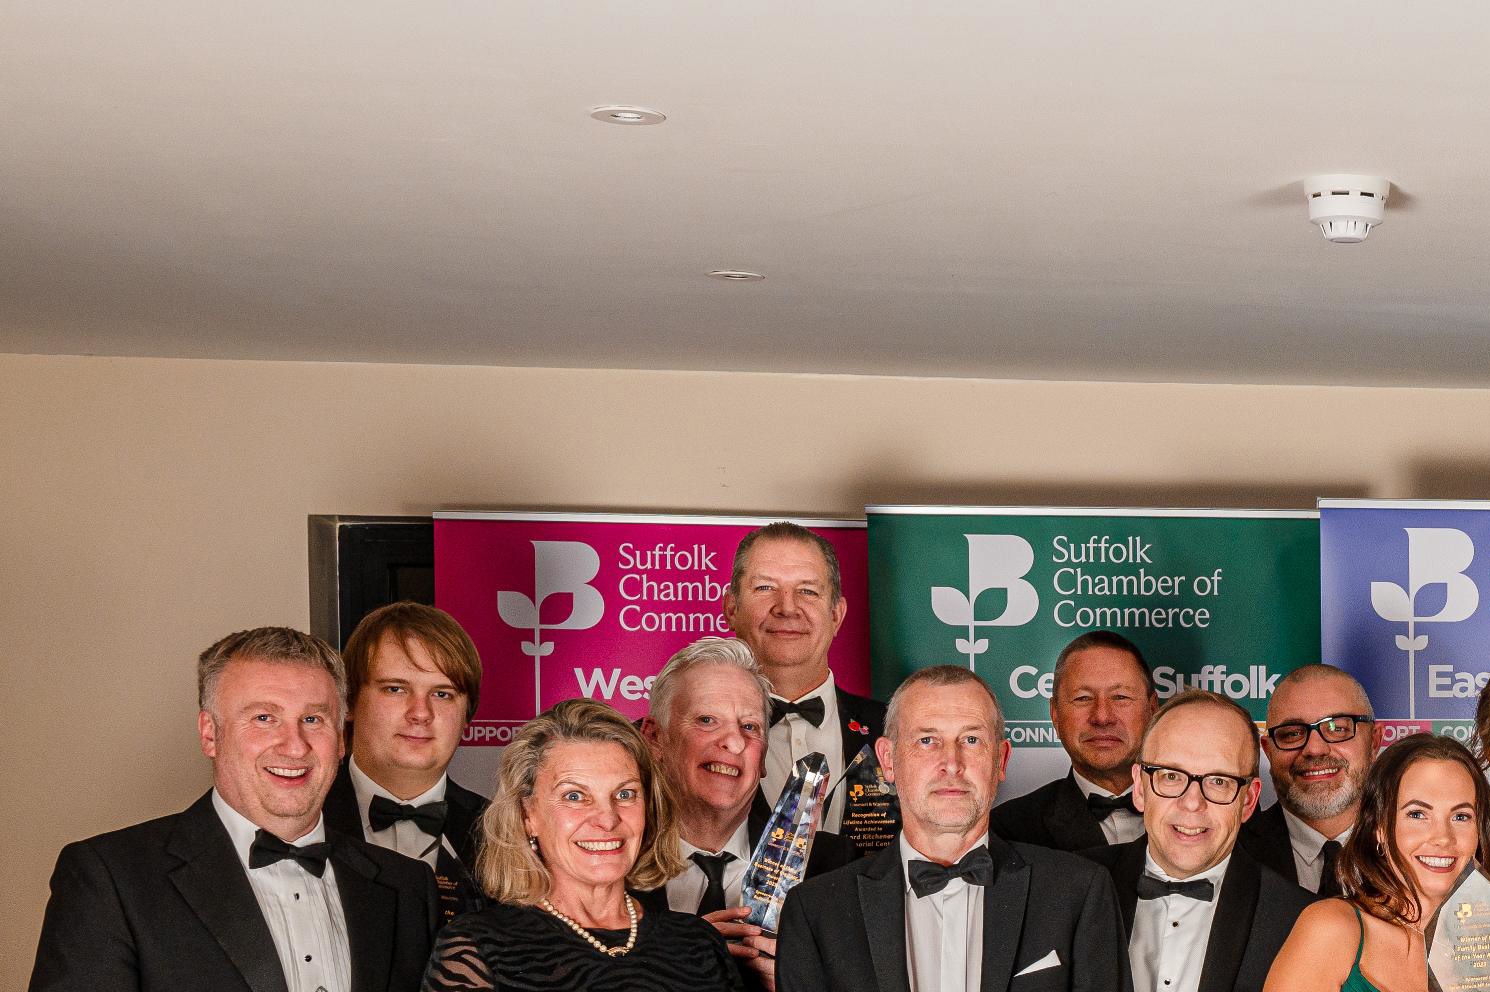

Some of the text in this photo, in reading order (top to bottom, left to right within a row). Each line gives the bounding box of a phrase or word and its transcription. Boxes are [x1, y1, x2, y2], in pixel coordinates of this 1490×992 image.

[619, 543, 717, 571] Suffolk
[1052, 536, 1152, 563] Suffolk
[619, 575, 731, 602] Chambe
[1053, 568, 1222, 596] Chamber of
[619, 606, 731, 633] Comme
[1053, 600, 1210, 627] Commerce
[574, 668, 654, 700] Wes
[1153, 664, 1282, 699] Suffolk
[1428, 664, 1490, 699] Eas
